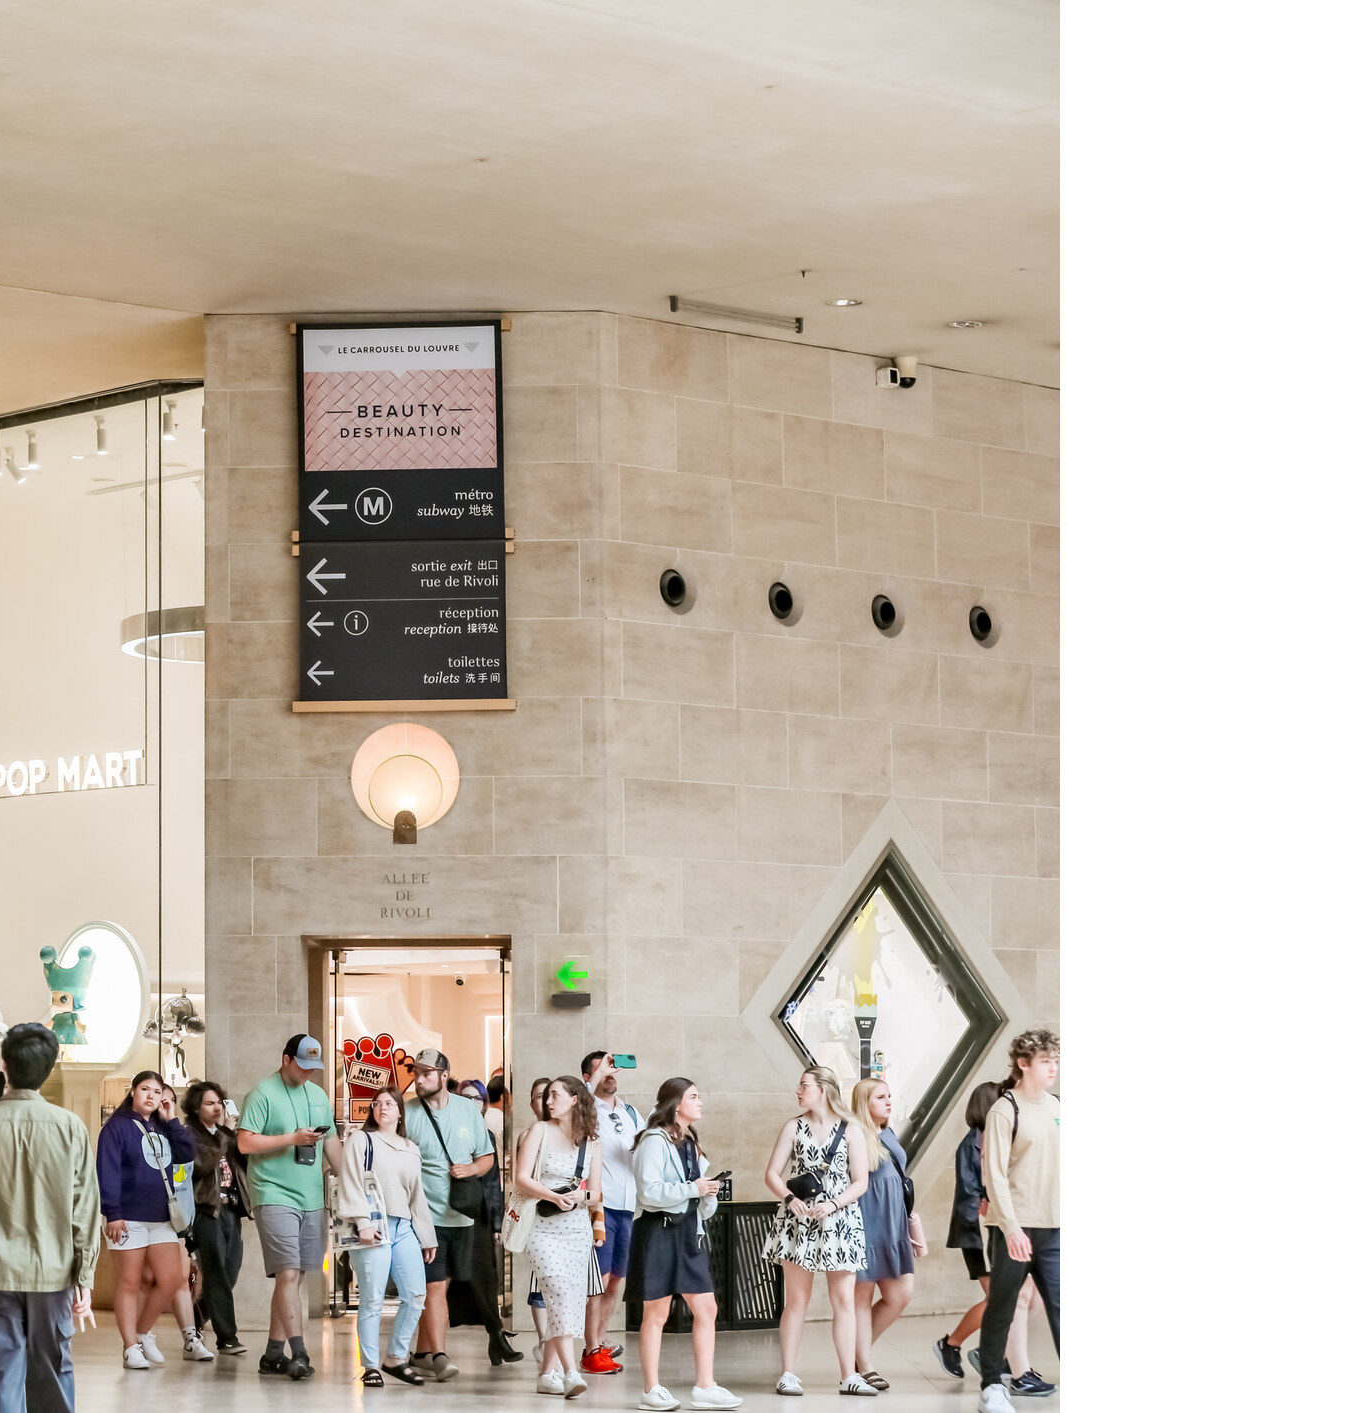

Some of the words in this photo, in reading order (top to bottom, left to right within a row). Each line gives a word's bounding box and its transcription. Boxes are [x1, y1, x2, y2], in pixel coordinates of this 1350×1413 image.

[350, 345, 404, 354] CARROUSEL
[407, 345, 421, 353] DU
[423, 344, 460, 352] LOUVRE
[357, 404, 443, 418] BEAUTY
[340, 426, 461, 438] DESTINATION
[455, 489, 494, 500] métro
[363, 497, 384, 515] M
[417, 504, 465, 519] subway
[469, 504, 494, 516] 地铁
[411, 560, 447, 571] sortie
[450, 560, 472, 571] exit
[477, 560, 498, 571] 出口
[420, 577, 441, 587] rue
[445, 575, 460, 586] de
[464, 575, 499, 587] Rivoli
[439, 607, 499, 620] réception
[404, 623, 462, 638] reception
[467, 623, 498, 633] 接待处
[448, 656, 500, 668] toilettes
[423, 672, 460, 684] toilets
[465, 672, 500, 683] 洗手间
[57, 749, 144, 792] MART
[396, 891, 414, 901] DE
[380, 907, 430, 918] RIVOLI
[358, 1067, 381, 1080] NEW
